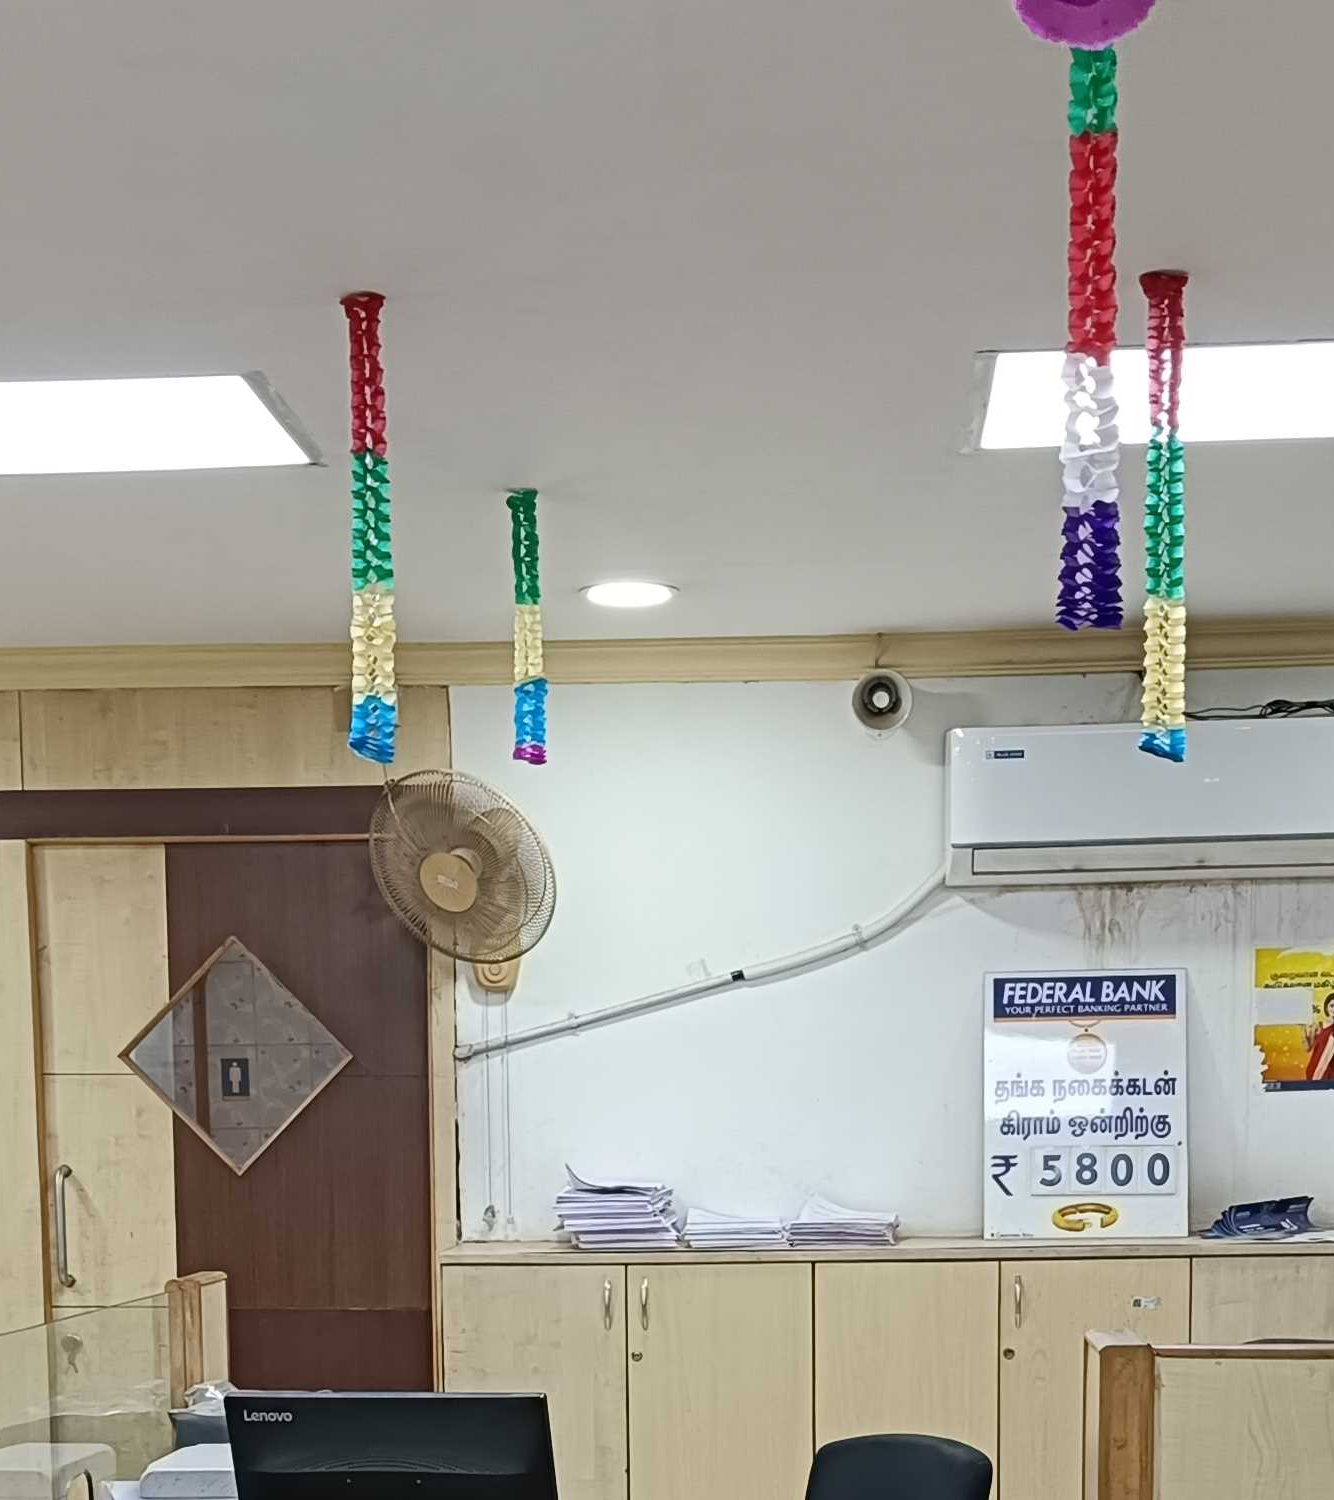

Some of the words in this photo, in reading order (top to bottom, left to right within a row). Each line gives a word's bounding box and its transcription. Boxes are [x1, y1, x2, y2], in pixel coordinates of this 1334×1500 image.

[1002, 981, 1096, 1004] FEDERAL
[1100, 979, 1167, 1002] BANK
[1034, 1005, 1075, 1014] PERFECT
[1078, 1004, 1121, 1013] BANKING
[1124, 1003, 1168, 1012] PARTNER
[994, 1072, 1045, 1104] தங்க
[1053, 1070, 1177, 1104] நகைக்கடன்
[999, 1108, 1061, 1141] கிராம்
[1068, 1106, 1172, 1140] ஒன்றிற்கு
[991, 1155, 1018, 1196] ₹
[1039, 1153, 1170, 1187] 5800
[243, 1409, 293, 1422] Lenovo
